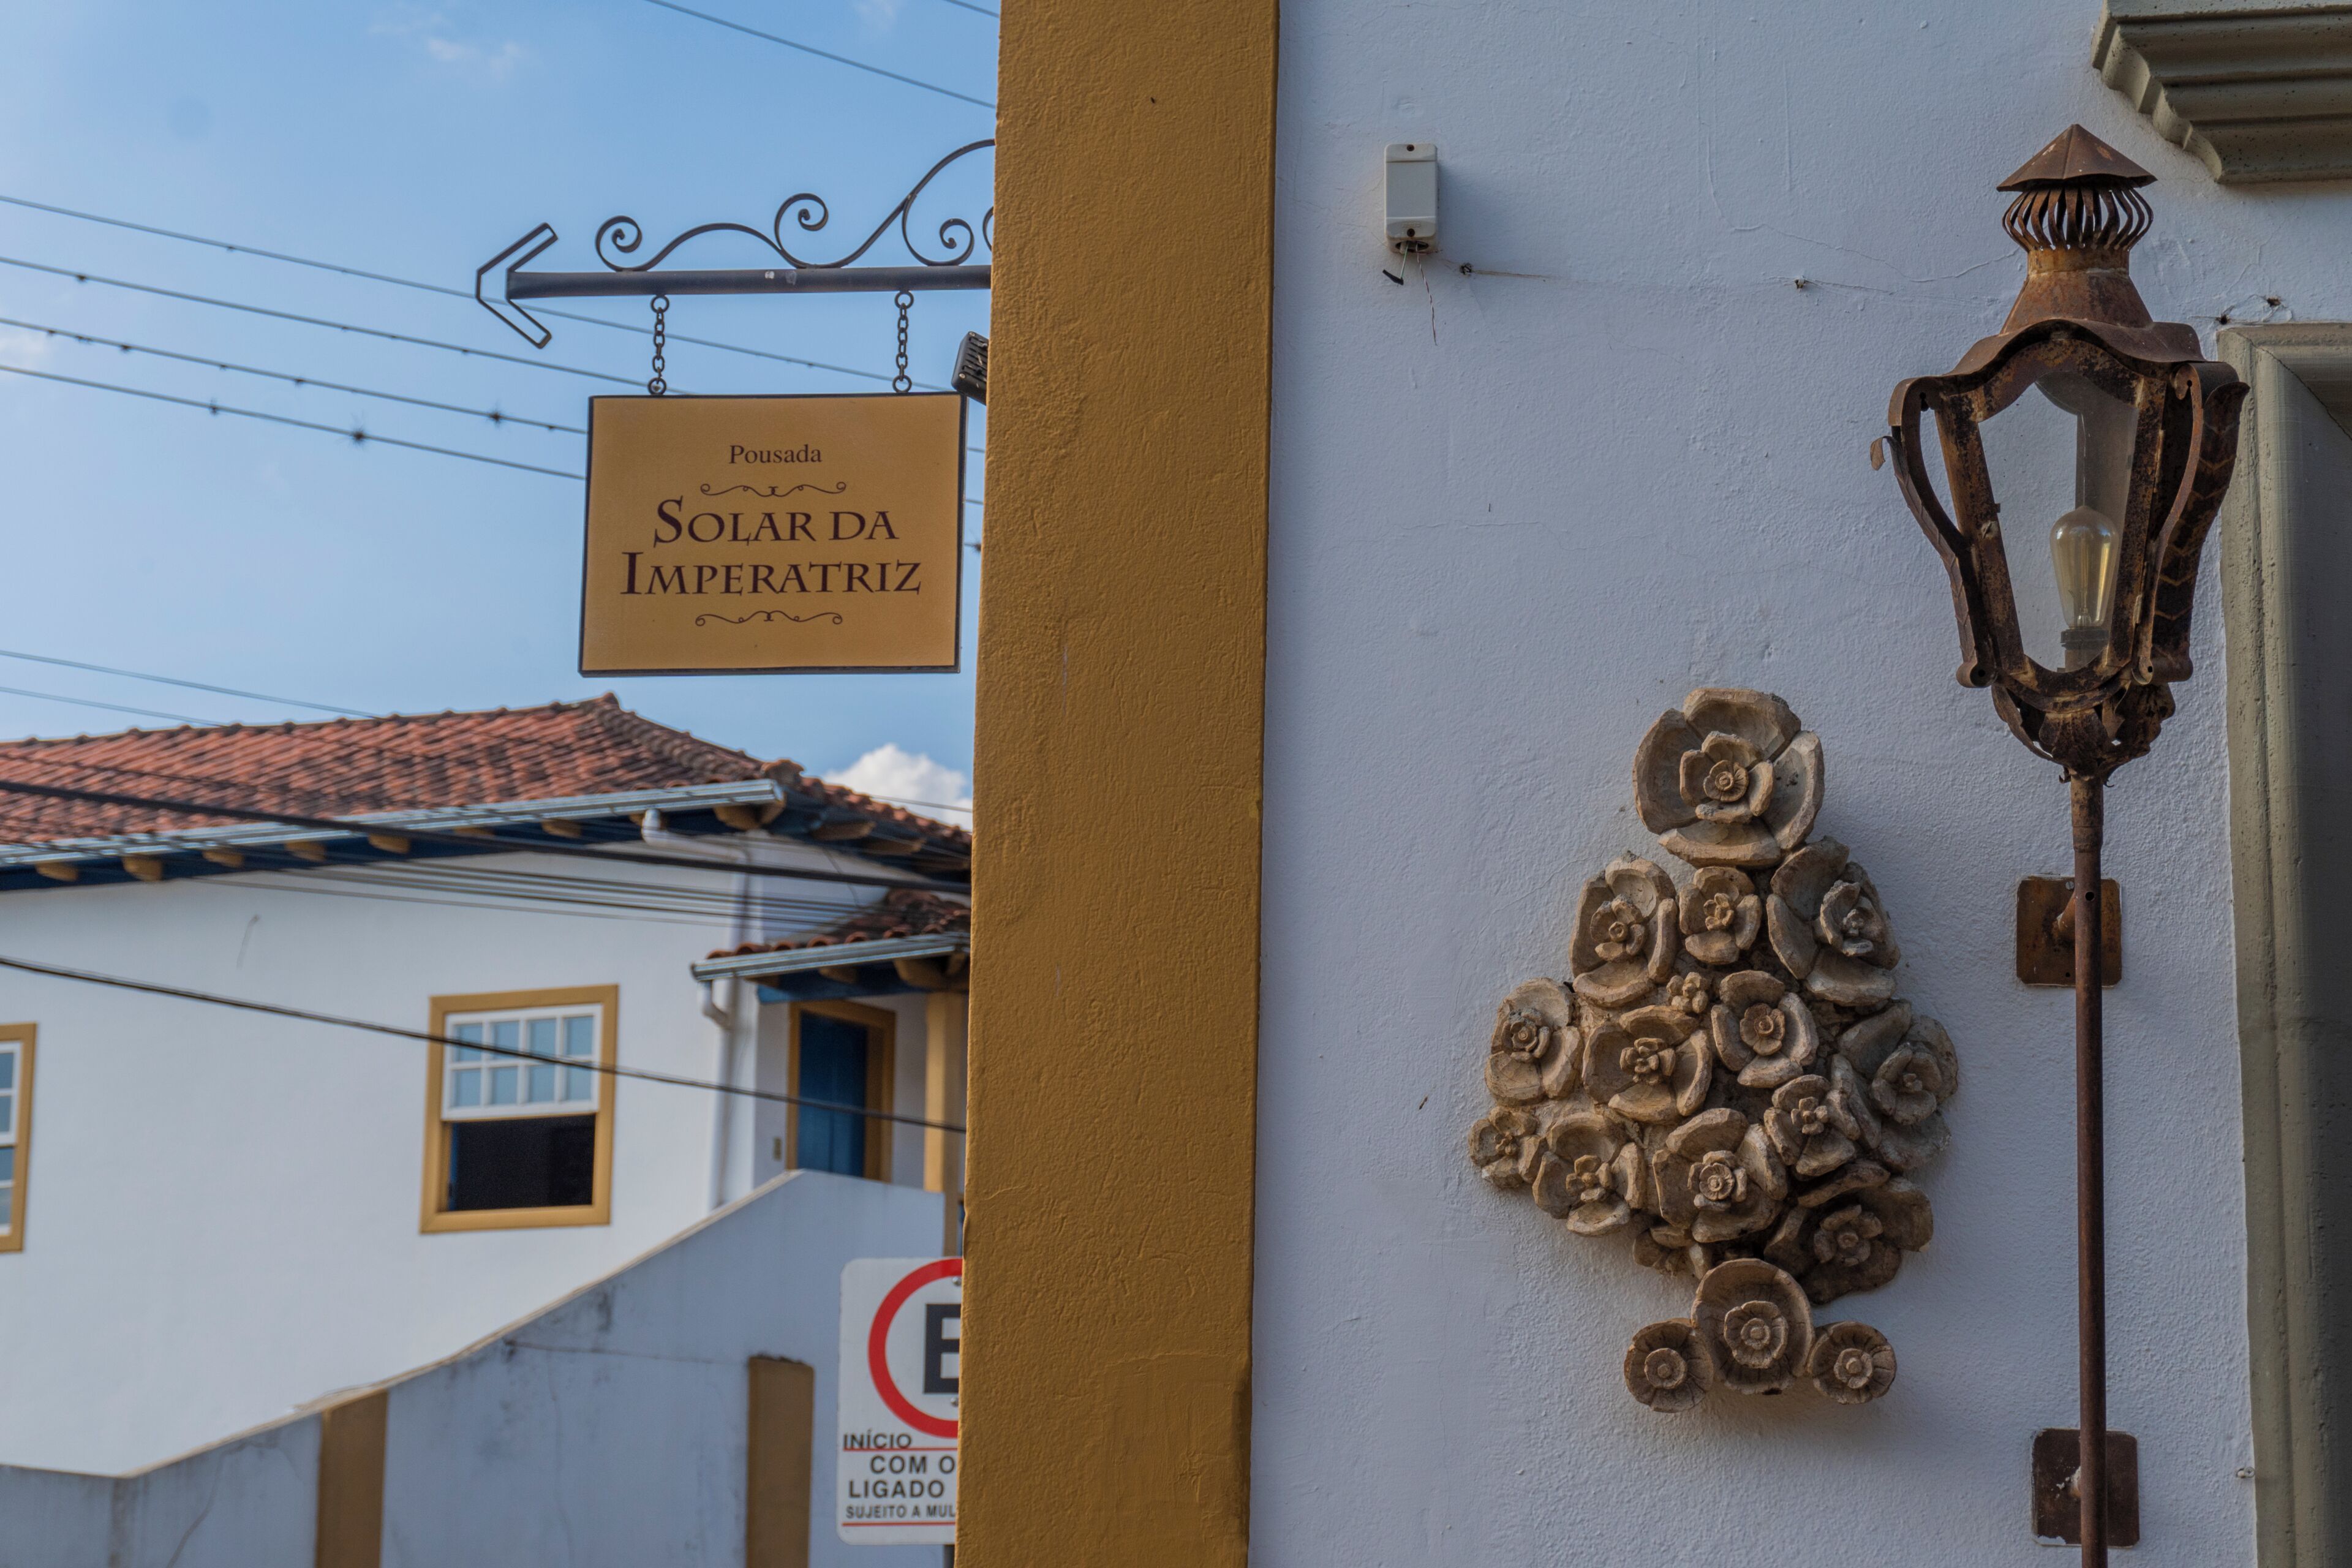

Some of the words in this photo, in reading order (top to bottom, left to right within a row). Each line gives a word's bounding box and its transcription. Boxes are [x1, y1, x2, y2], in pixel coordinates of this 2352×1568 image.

[729, 444, 822, 464] Pousada
[654, 496, 816, 548] SOLAR
[829, 511, 900, 541] DA
[620, 552, 922, 596] IMPERATRIZ
[843, 1429, 912, 1449] INÍCIO
[870, 1455, 927, 1474] COM
[939, 1455, 956, 1474] O
[849, 1480, 944, 1499] LIGADO
[846, 1506, 907, 1518] SUJEITO
[911, 1506, 921, 1517] A
